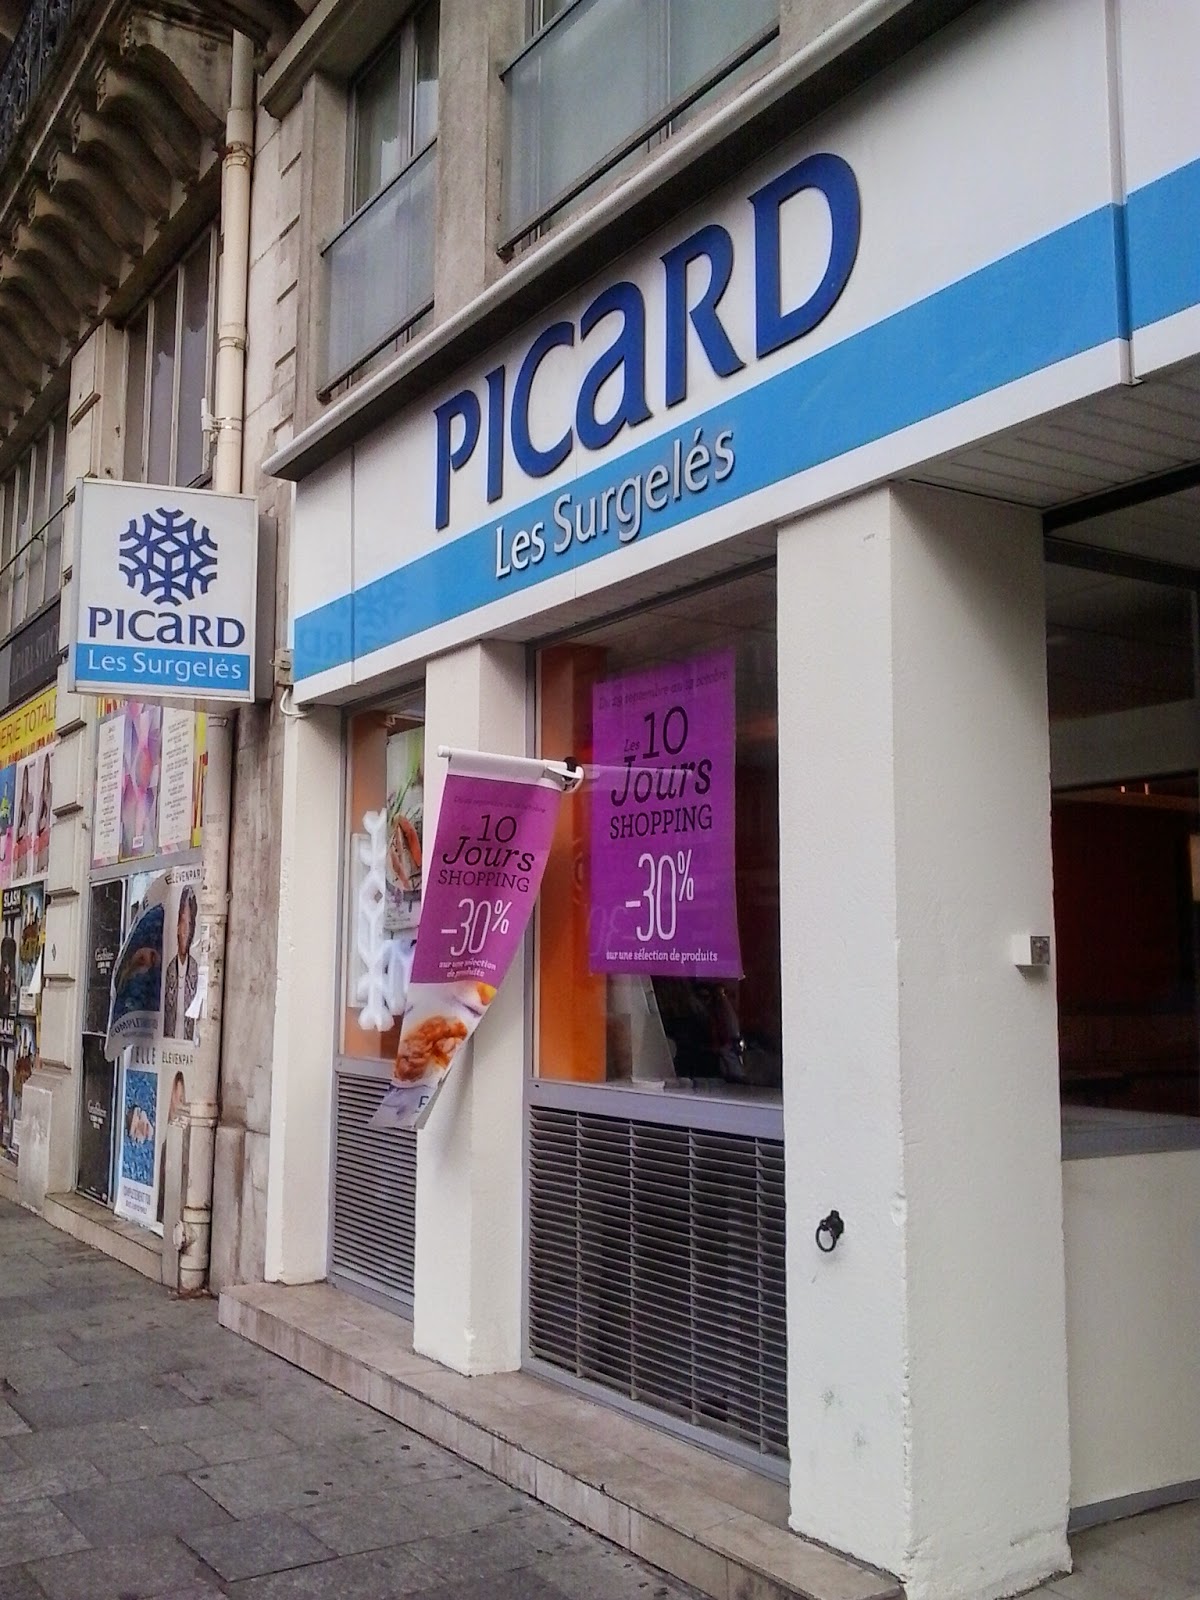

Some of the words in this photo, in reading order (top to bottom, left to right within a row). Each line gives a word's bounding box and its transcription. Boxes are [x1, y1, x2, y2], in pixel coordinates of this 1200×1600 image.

[495, 525, 545, 578] Les
[552, 428, 736, 543] Surgelés
[88, 650, 126, 672] Les
[133, 652, 242, 681] Surgelés
[624, 739, 641, 752] Les
[642, 706, 689, 759] 10
[611, 755, 713, 807] Jours
[477, 814, 517, 843] 10
[610, 804, 713, 840] SHOPPING
[442, 836, 536, 872] Jours
[438, 869, 530, 893] SHOPPING
[625, 849, 694, 942] -30%
[441, 898, 513, 957] -30%
[619, 951, 633, 961] une
[633, 948, 669, 962] sélection
[670, 949, 680, 962] de
[681, 949, 718, 964] produits
